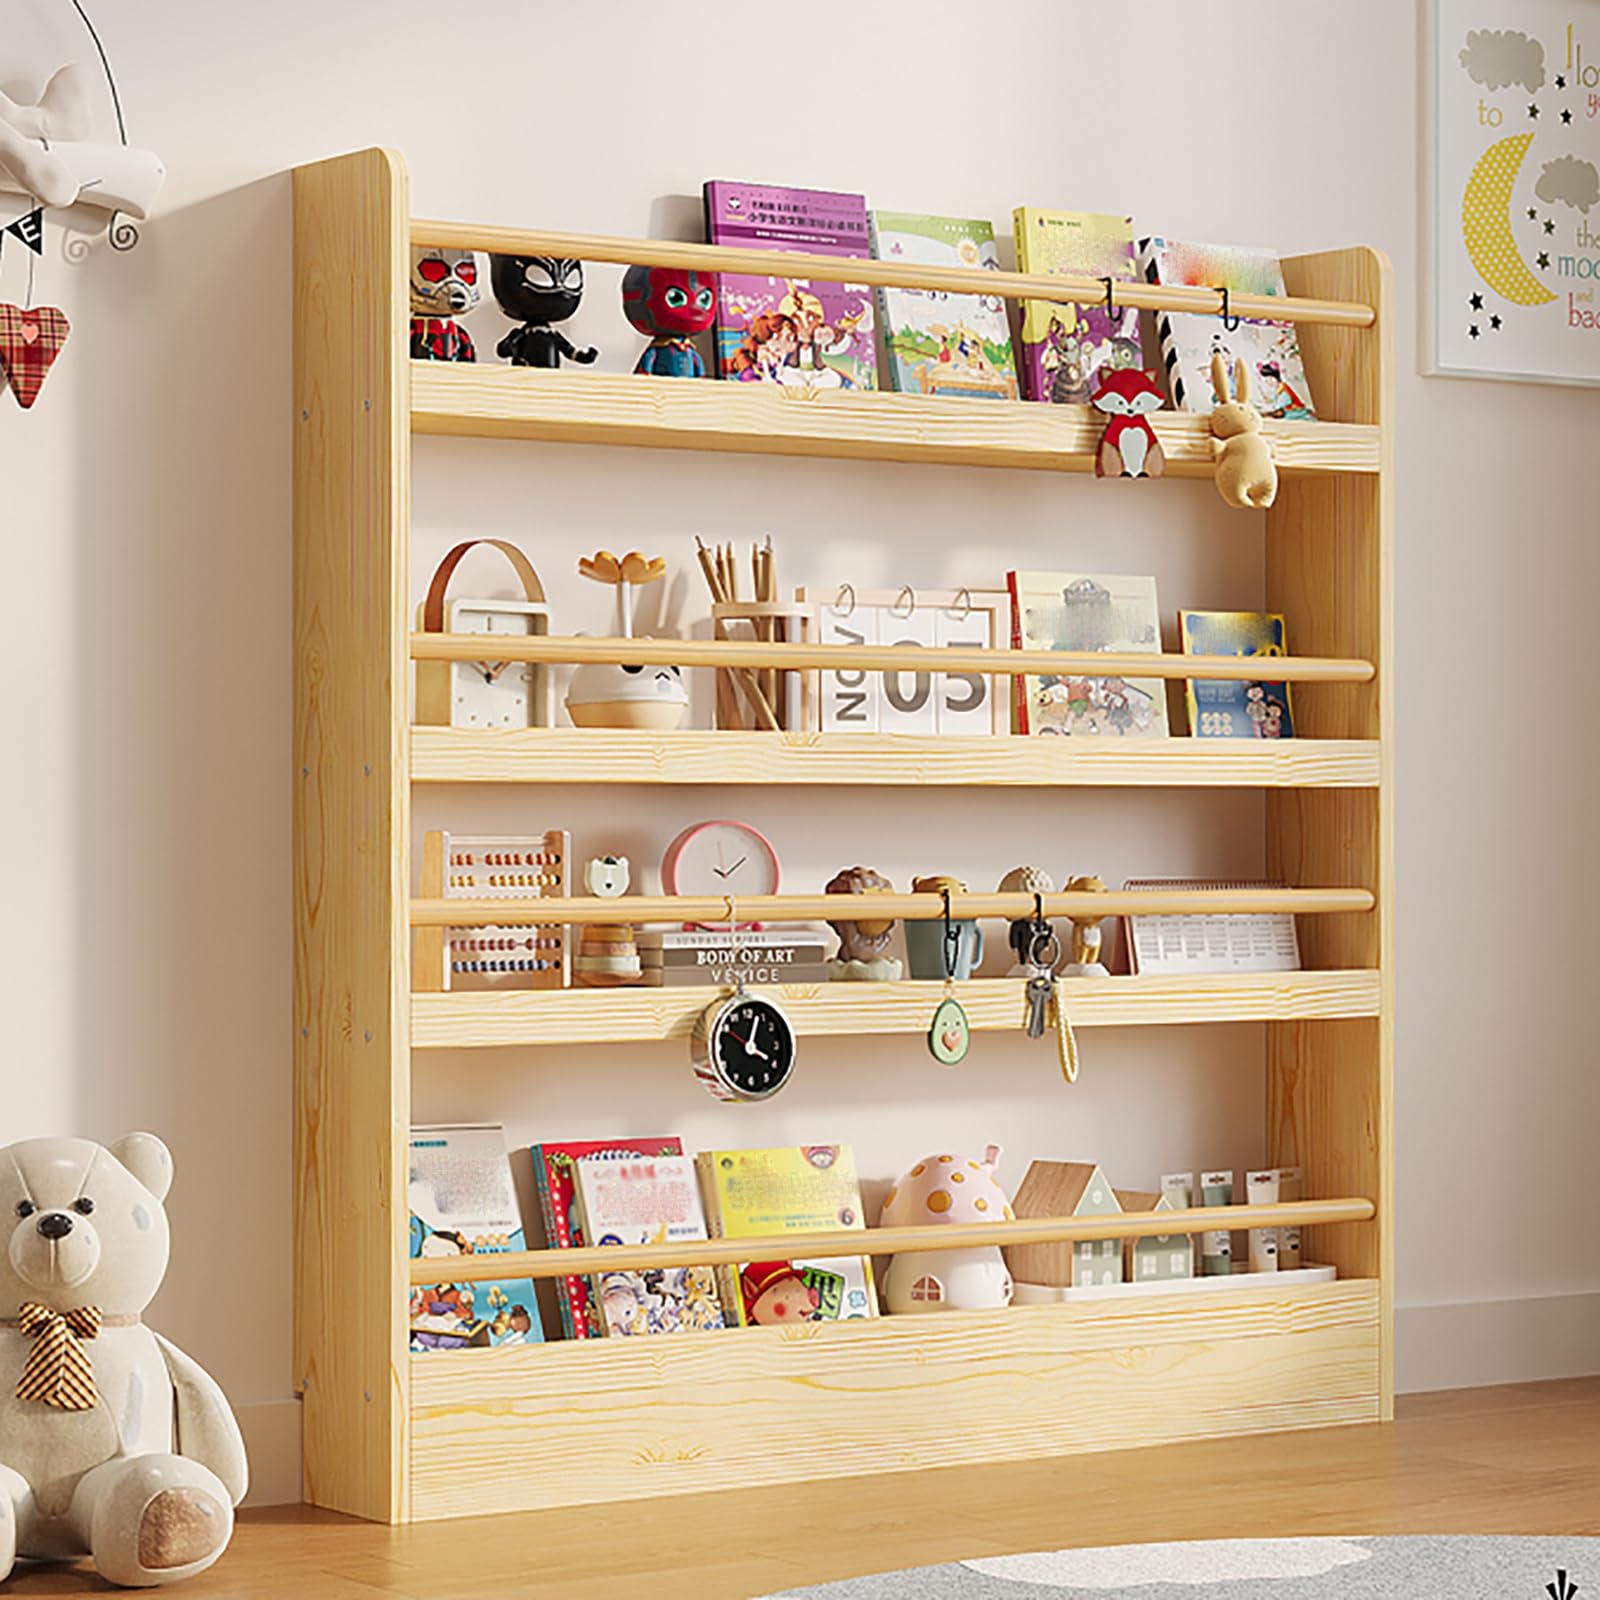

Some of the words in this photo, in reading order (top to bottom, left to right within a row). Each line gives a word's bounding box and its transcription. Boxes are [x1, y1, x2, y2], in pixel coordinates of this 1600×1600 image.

[1576, 43, 1600, 88] lo
[1478, 99, 1503, 128] to
[17, 216, 41, 242] E
[696, 950, 736, 965] BODY
[741, 950, 762, 963] OF
[765, 949, 795, 963] ART
[742, 1008, 753, 1019] 12
[841, 1208, 854, 1226] 6
